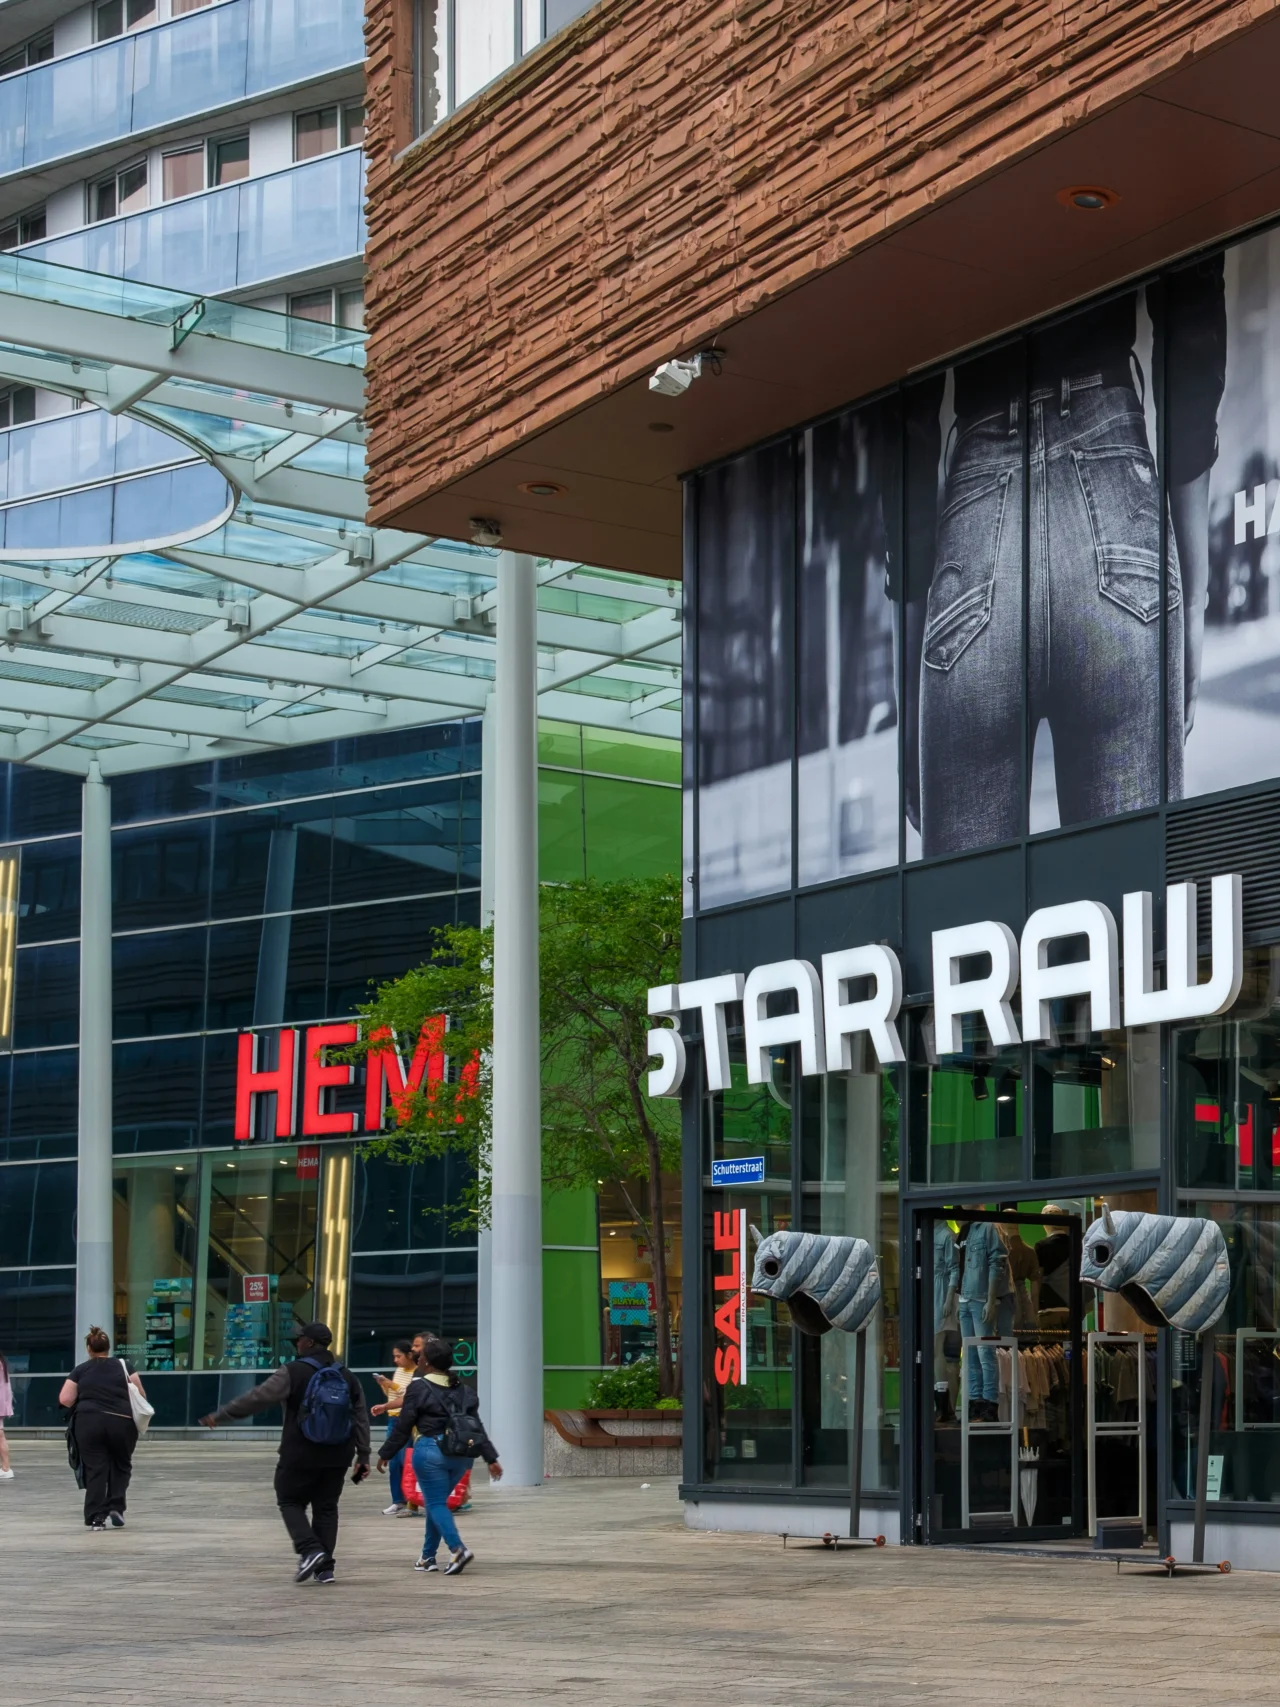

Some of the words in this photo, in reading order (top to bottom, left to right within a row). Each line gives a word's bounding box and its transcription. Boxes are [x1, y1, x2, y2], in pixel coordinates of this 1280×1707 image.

[931, 874, 1243, 1055] RAW
[298, 1157, 319, 1167] HEMA
[713, 1161, 763, 1176] Schutterstraat
[249, 1281, 264, 1291] 25%
[714, 1209, 740, 1387] SALE
